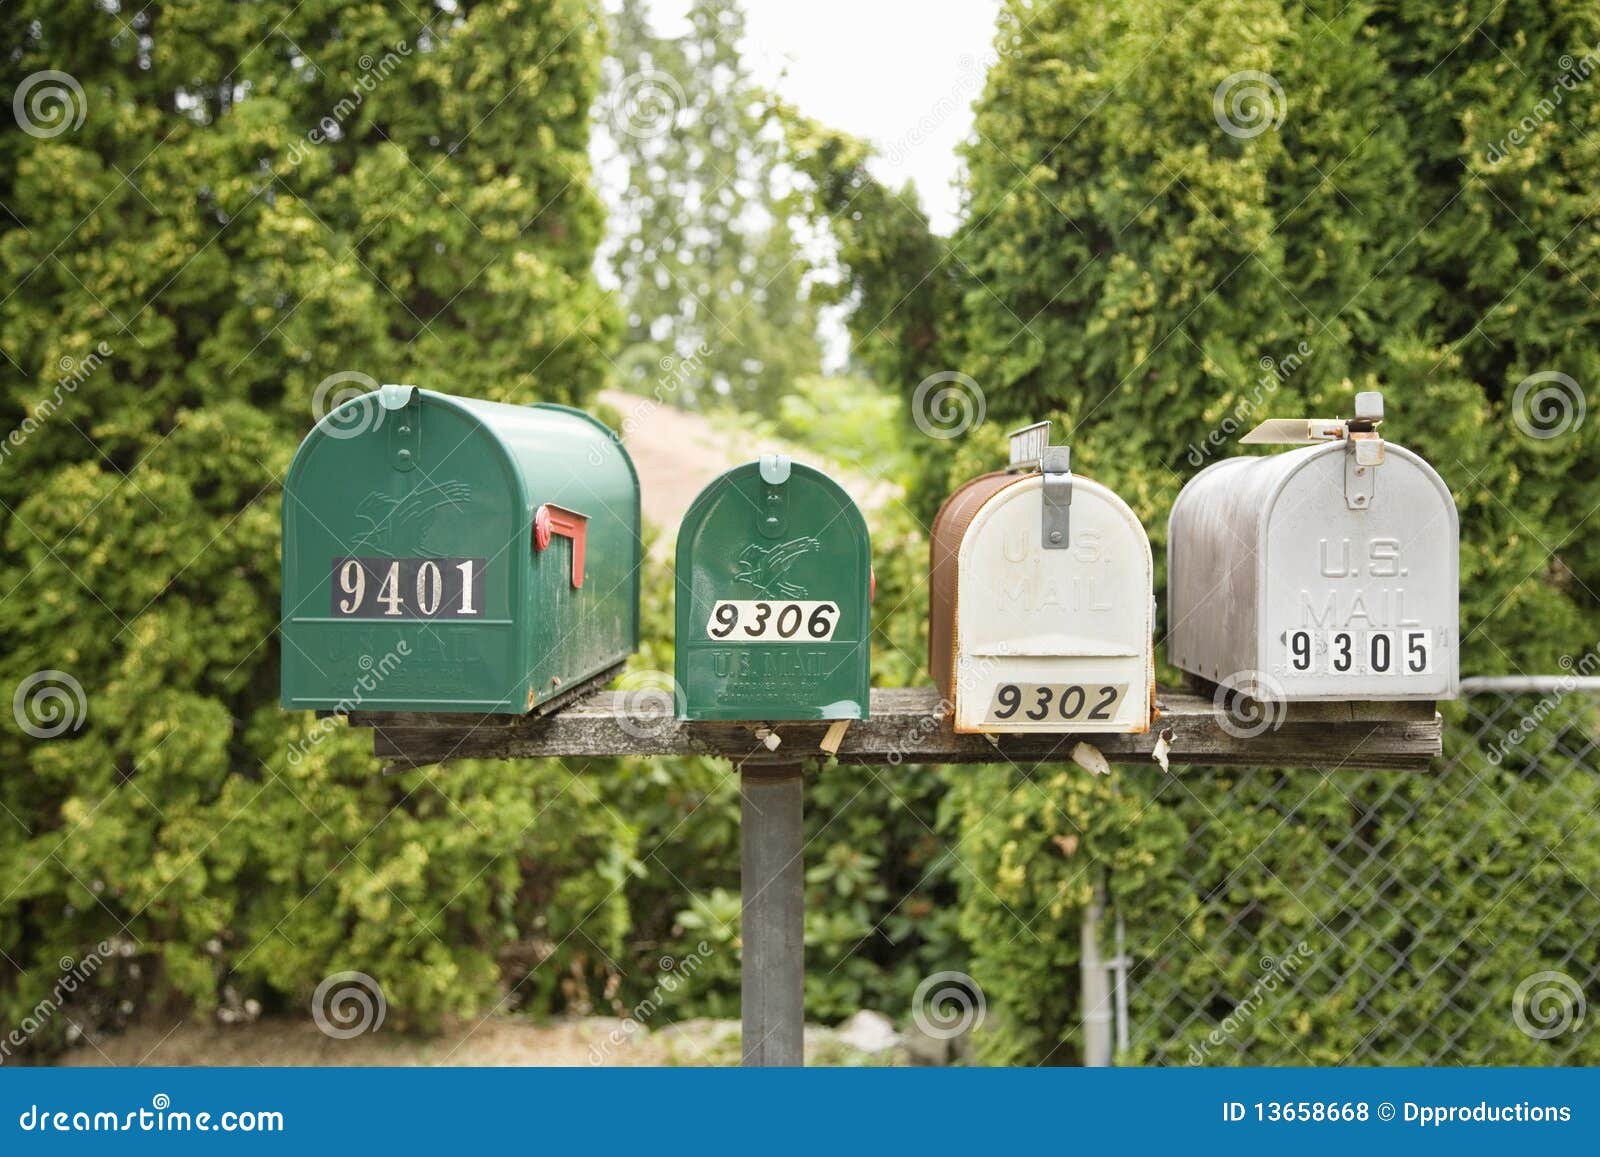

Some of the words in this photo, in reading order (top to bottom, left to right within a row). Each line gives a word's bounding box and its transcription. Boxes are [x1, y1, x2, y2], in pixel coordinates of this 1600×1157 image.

[1319, 538, 1409, 578] U.S.
[340, 560, 478, 615] 9401
[997, 575, 1113, 613] MAIL
[711, 603, 835, 638] 9306
[1300, 588, 1421, 628] MAIL
[1291, 631, 1427, 673] 9305
[994, 684, 1118, 721] 9302
